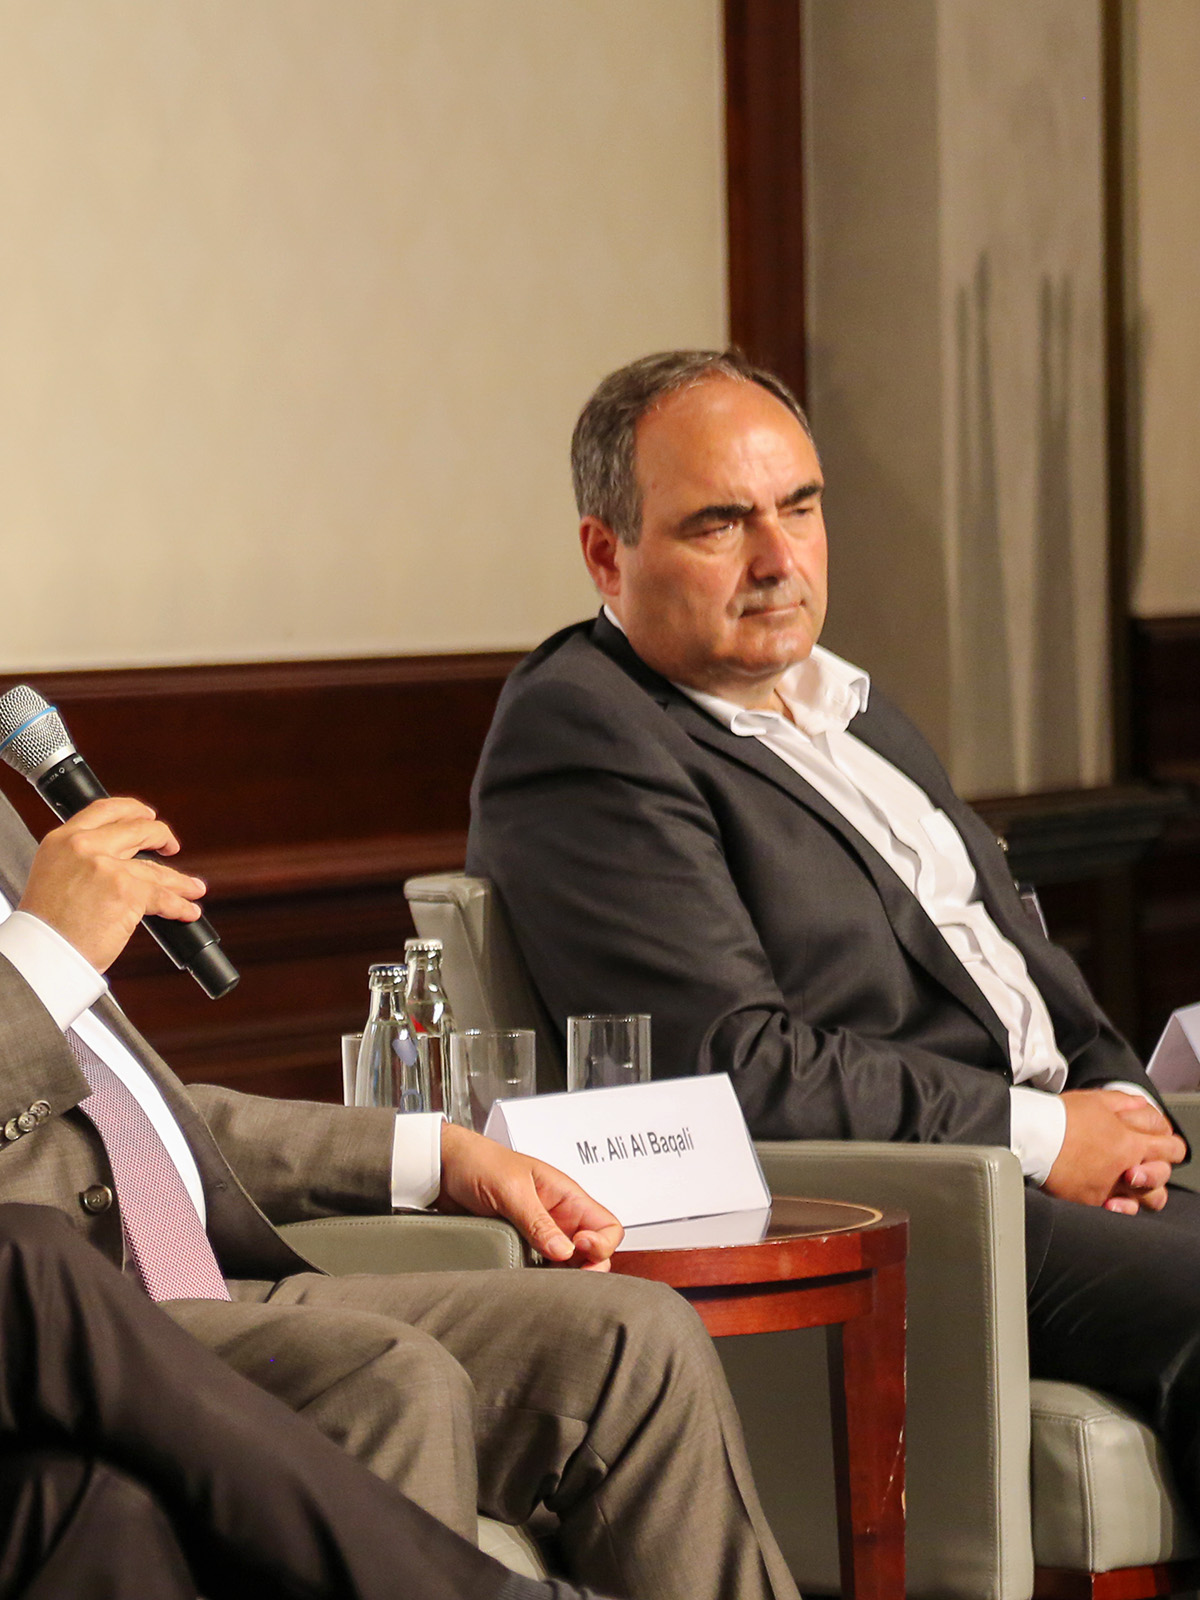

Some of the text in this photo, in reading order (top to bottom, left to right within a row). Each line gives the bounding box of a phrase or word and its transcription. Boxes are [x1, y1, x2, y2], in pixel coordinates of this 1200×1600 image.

[576, 1126, 695, 1165] Mr. Ali Al Baqali
